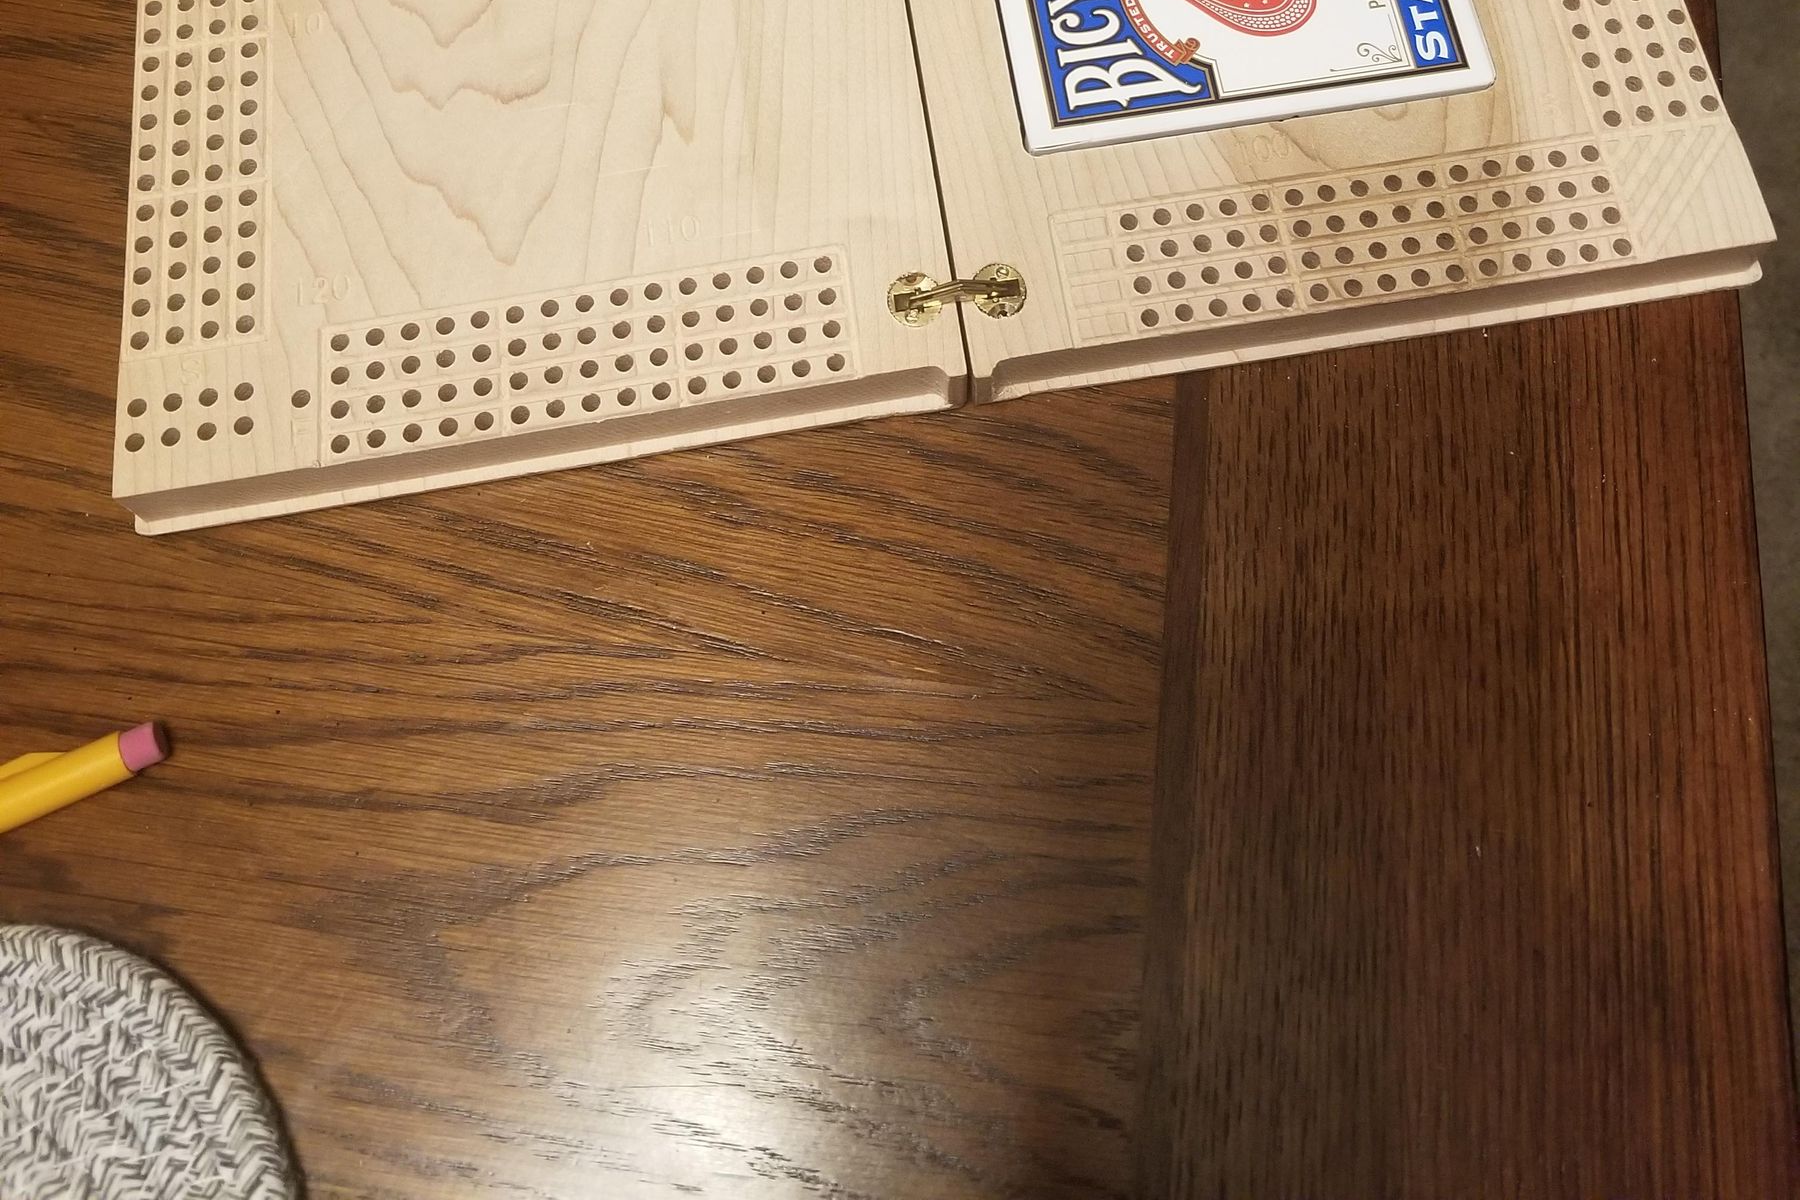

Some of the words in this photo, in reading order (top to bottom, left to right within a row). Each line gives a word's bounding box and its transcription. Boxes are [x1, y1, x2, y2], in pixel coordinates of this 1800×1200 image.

[1235, 134, 1291, 166] 100
[643, 215, 702, 246] 110
[294, 273, 353, 306] 120
